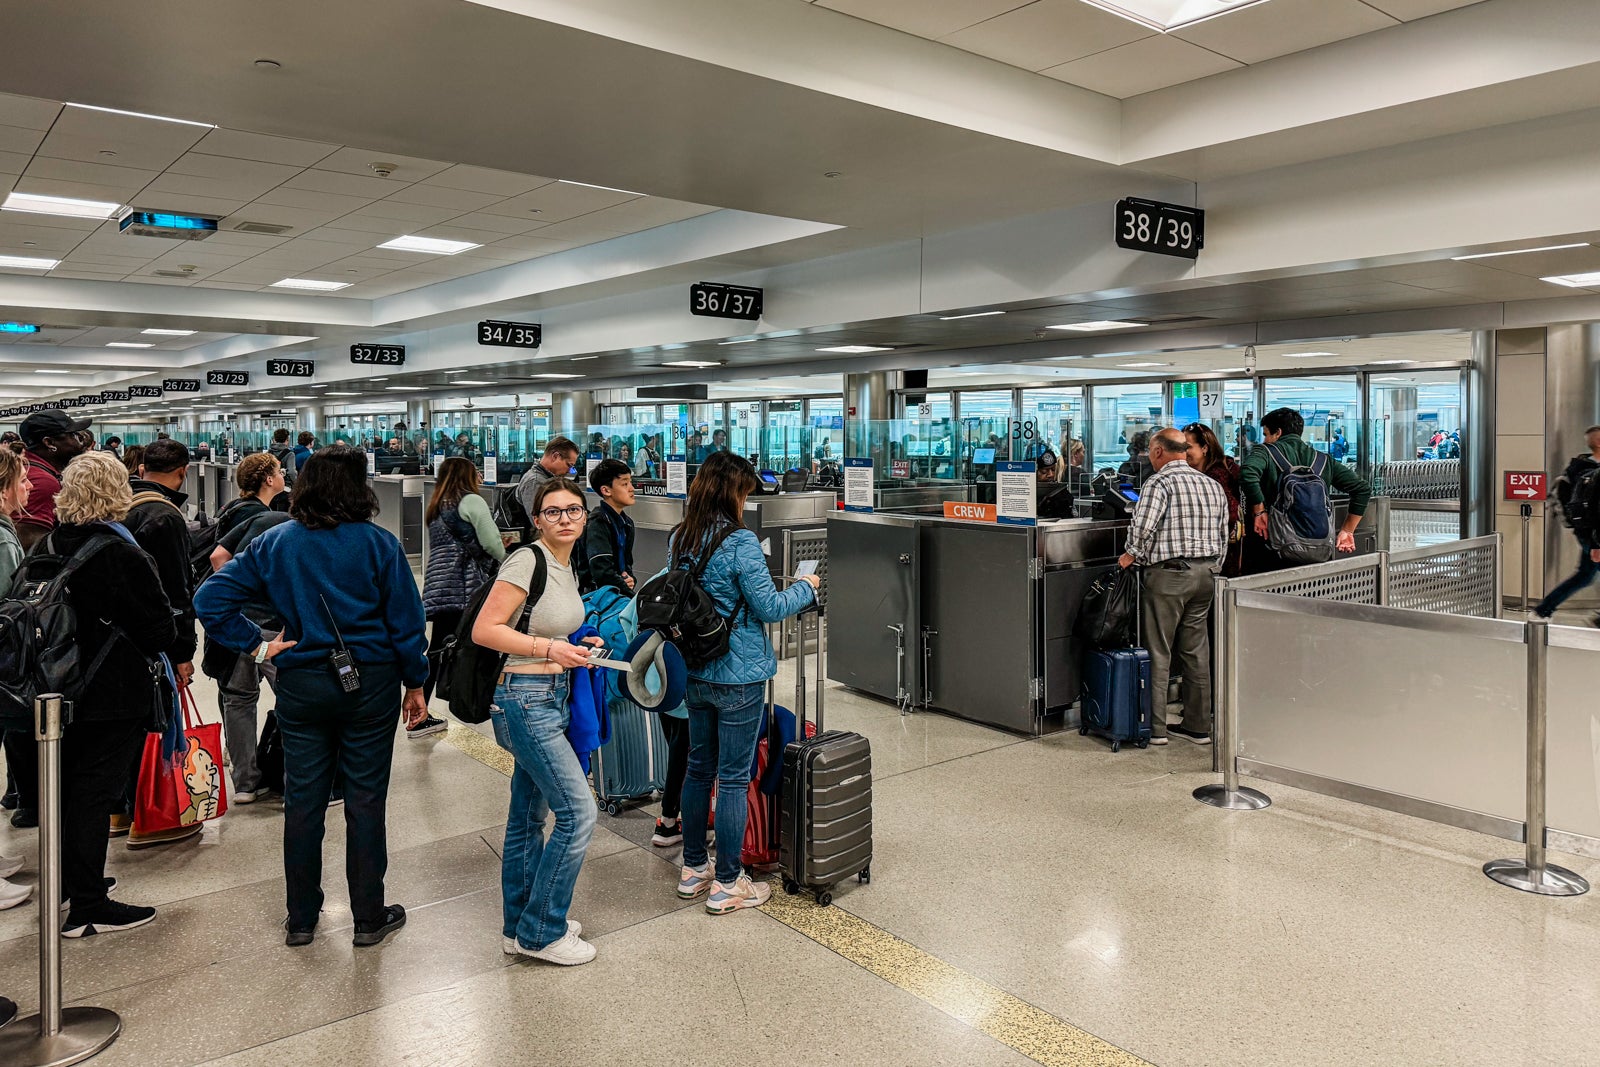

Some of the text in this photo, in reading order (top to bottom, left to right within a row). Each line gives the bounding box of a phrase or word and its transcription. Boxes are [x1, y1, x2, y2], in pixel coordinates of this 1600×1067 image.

[1123, 210, 1193, 249] 38/39
[696, 290, 754, 314] 36/37
[482, 326, 534, 344] 34/35
[354, 348, 399, 362] 32/33
[273, 363, 309, 375] 30/31
[210, 373, 245, 384] 28/29
[130, 387, 159, 396] 24/25
[165, 381, 196, 390] 26/27
[103, 392, 129, 400] 22/23
[1202, 393, 1219, 407] 37
[740, 410, 747, 419] 33
[920, 405, 930, 415] 35
[674, 425, 686, 440] 36
[1012, 420, 1034, 440] 38
[1510, 474, 1542, 486] EXIT
[644, 485, 668, 496] LIAISON
[953, 505, 985, 519] CREW
